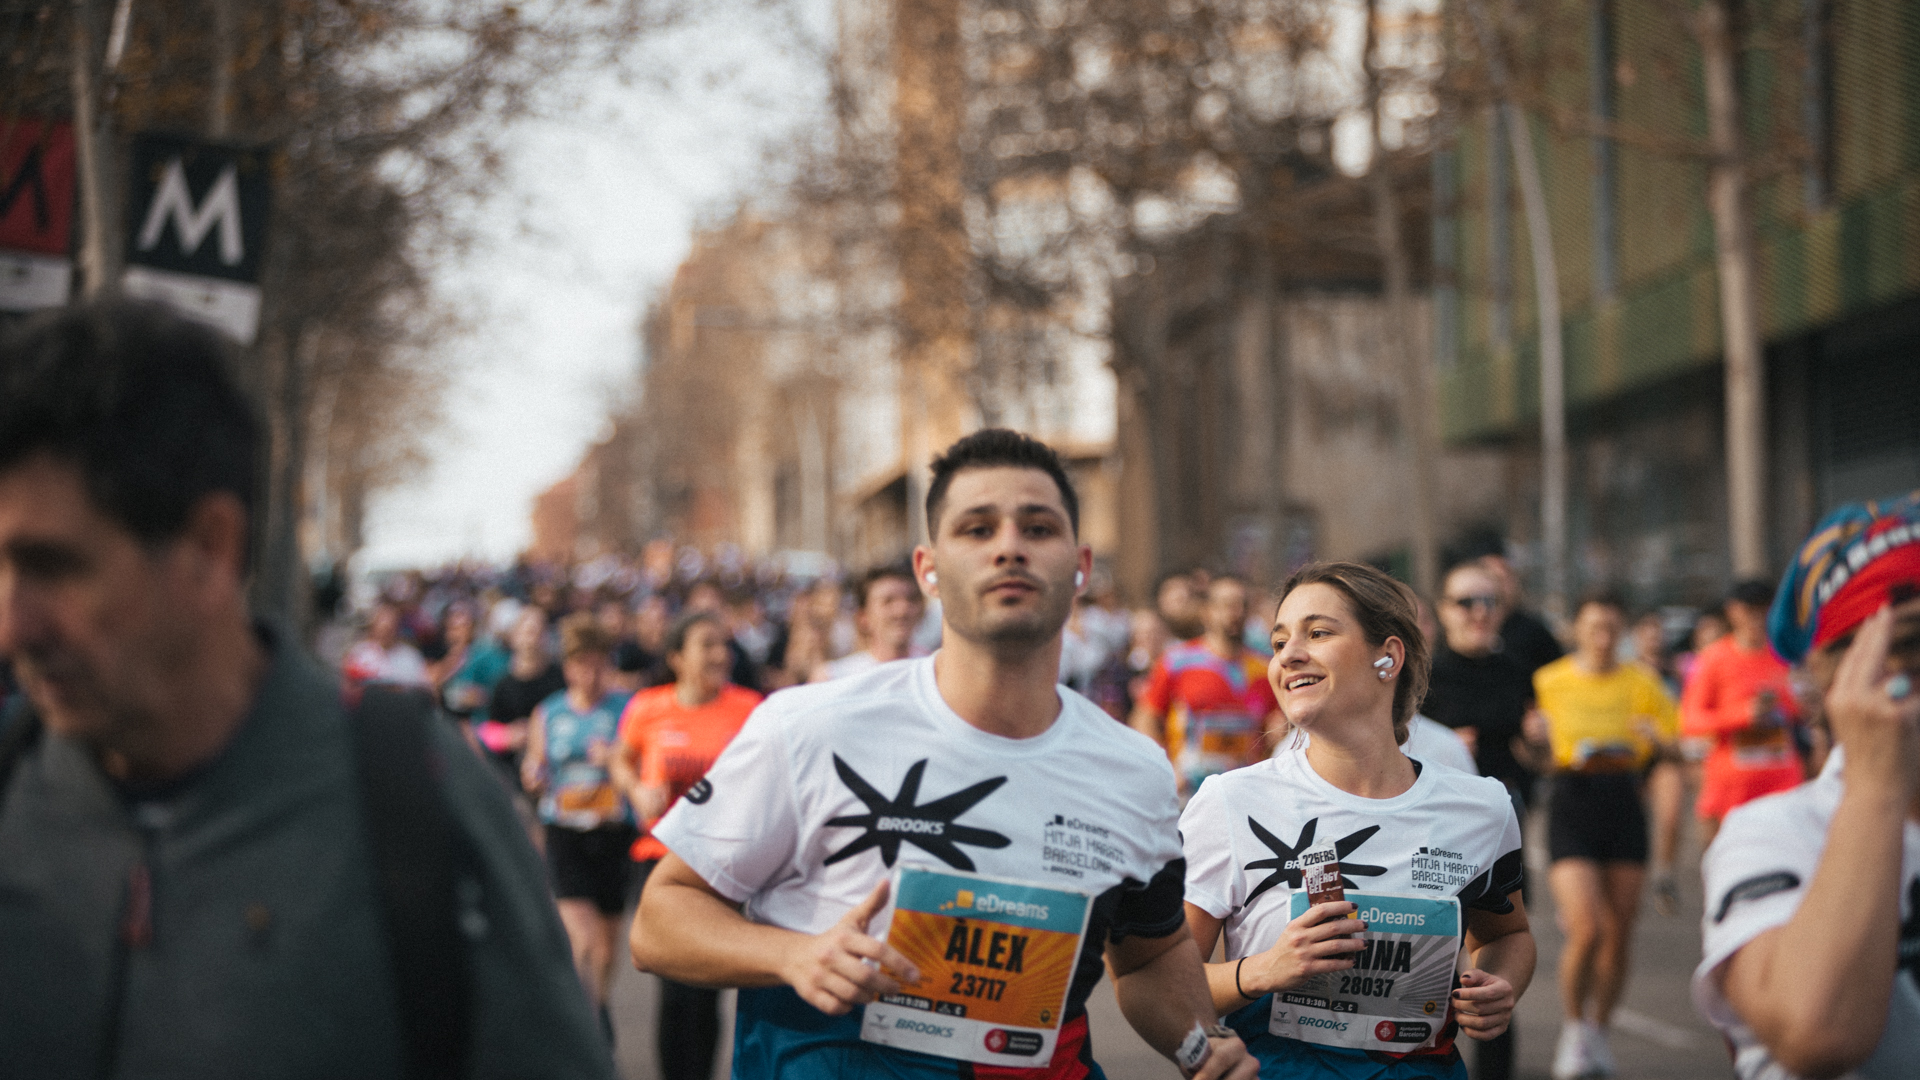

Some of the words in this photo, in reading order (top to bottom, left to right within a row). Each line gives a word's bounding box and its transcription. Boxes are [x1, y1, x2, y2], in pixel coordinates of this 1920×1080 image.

[139, 157, 243, 264] M
[876, 816, 945, 835] BROOKS
[1067, 818, 1110, 839] eDreams
[1302, 849, 1336, 867] 226ERS
[1430, 848, 1463, 860] eDreams
[1305, 865, 1325, 878] HIGH
[1411, 857, 1440, 871] MITJA
[1443, 861, 1480, 876] MARATÓ
[1307, 871, 1339, 887] ENERGY
[1411, 870, 1466, 886] BARCELONA
[1308, 884, 1325, 895] GEL
[976, 893, 1049, 921] eDreams
[1360, 907, 1426, 926] eDreams
[950, 972, 1008, 1002] 23717
[1339, 975, 1395, 998] 28037
[1286, 994, 1305, 1004] Start
[1306, 997, 1327, 1008] 9:30h
[895, 1018, 955, 1038] BROOKS
[1297, 1016, 1349, 1032] BROOKS
